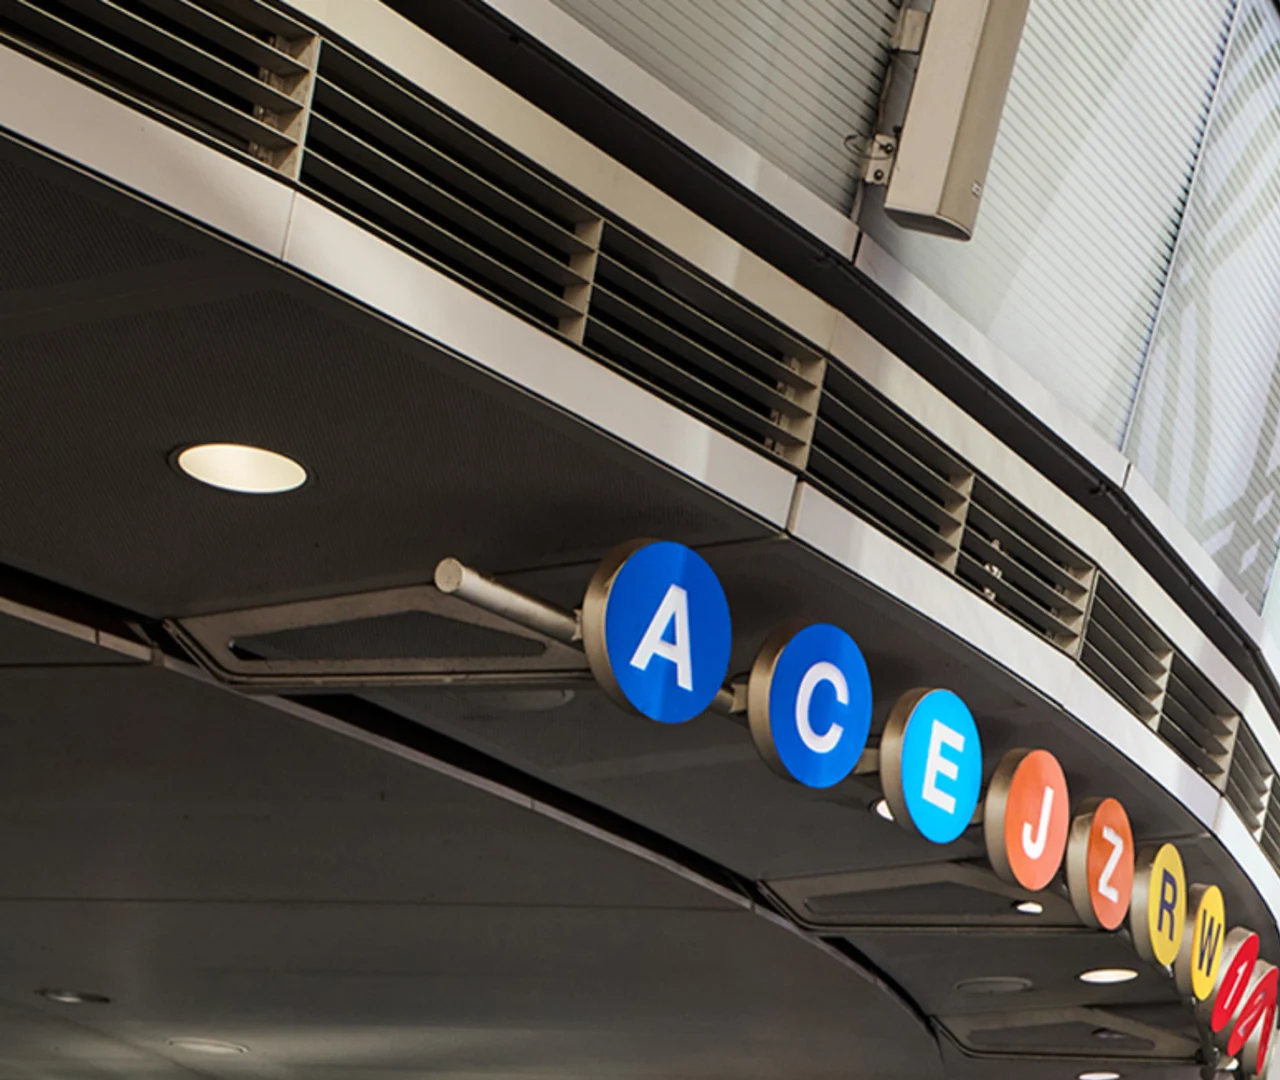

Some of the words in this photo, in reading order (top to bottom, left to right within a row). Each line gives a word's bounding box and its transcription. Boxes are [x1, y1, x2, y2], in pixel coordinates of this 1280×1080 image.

[629, 583, 694, 692] A
[795, 661, 849, 754] C
[921, 719, 965, 815] E
[1021, 785, 1055, 860] J
[1098, 825, 1124, 904] Z
[1157, 868, 1178, 942] R
[1197, 909, 1222, 977] W
[1223, 960, 1249, 1010] 1
